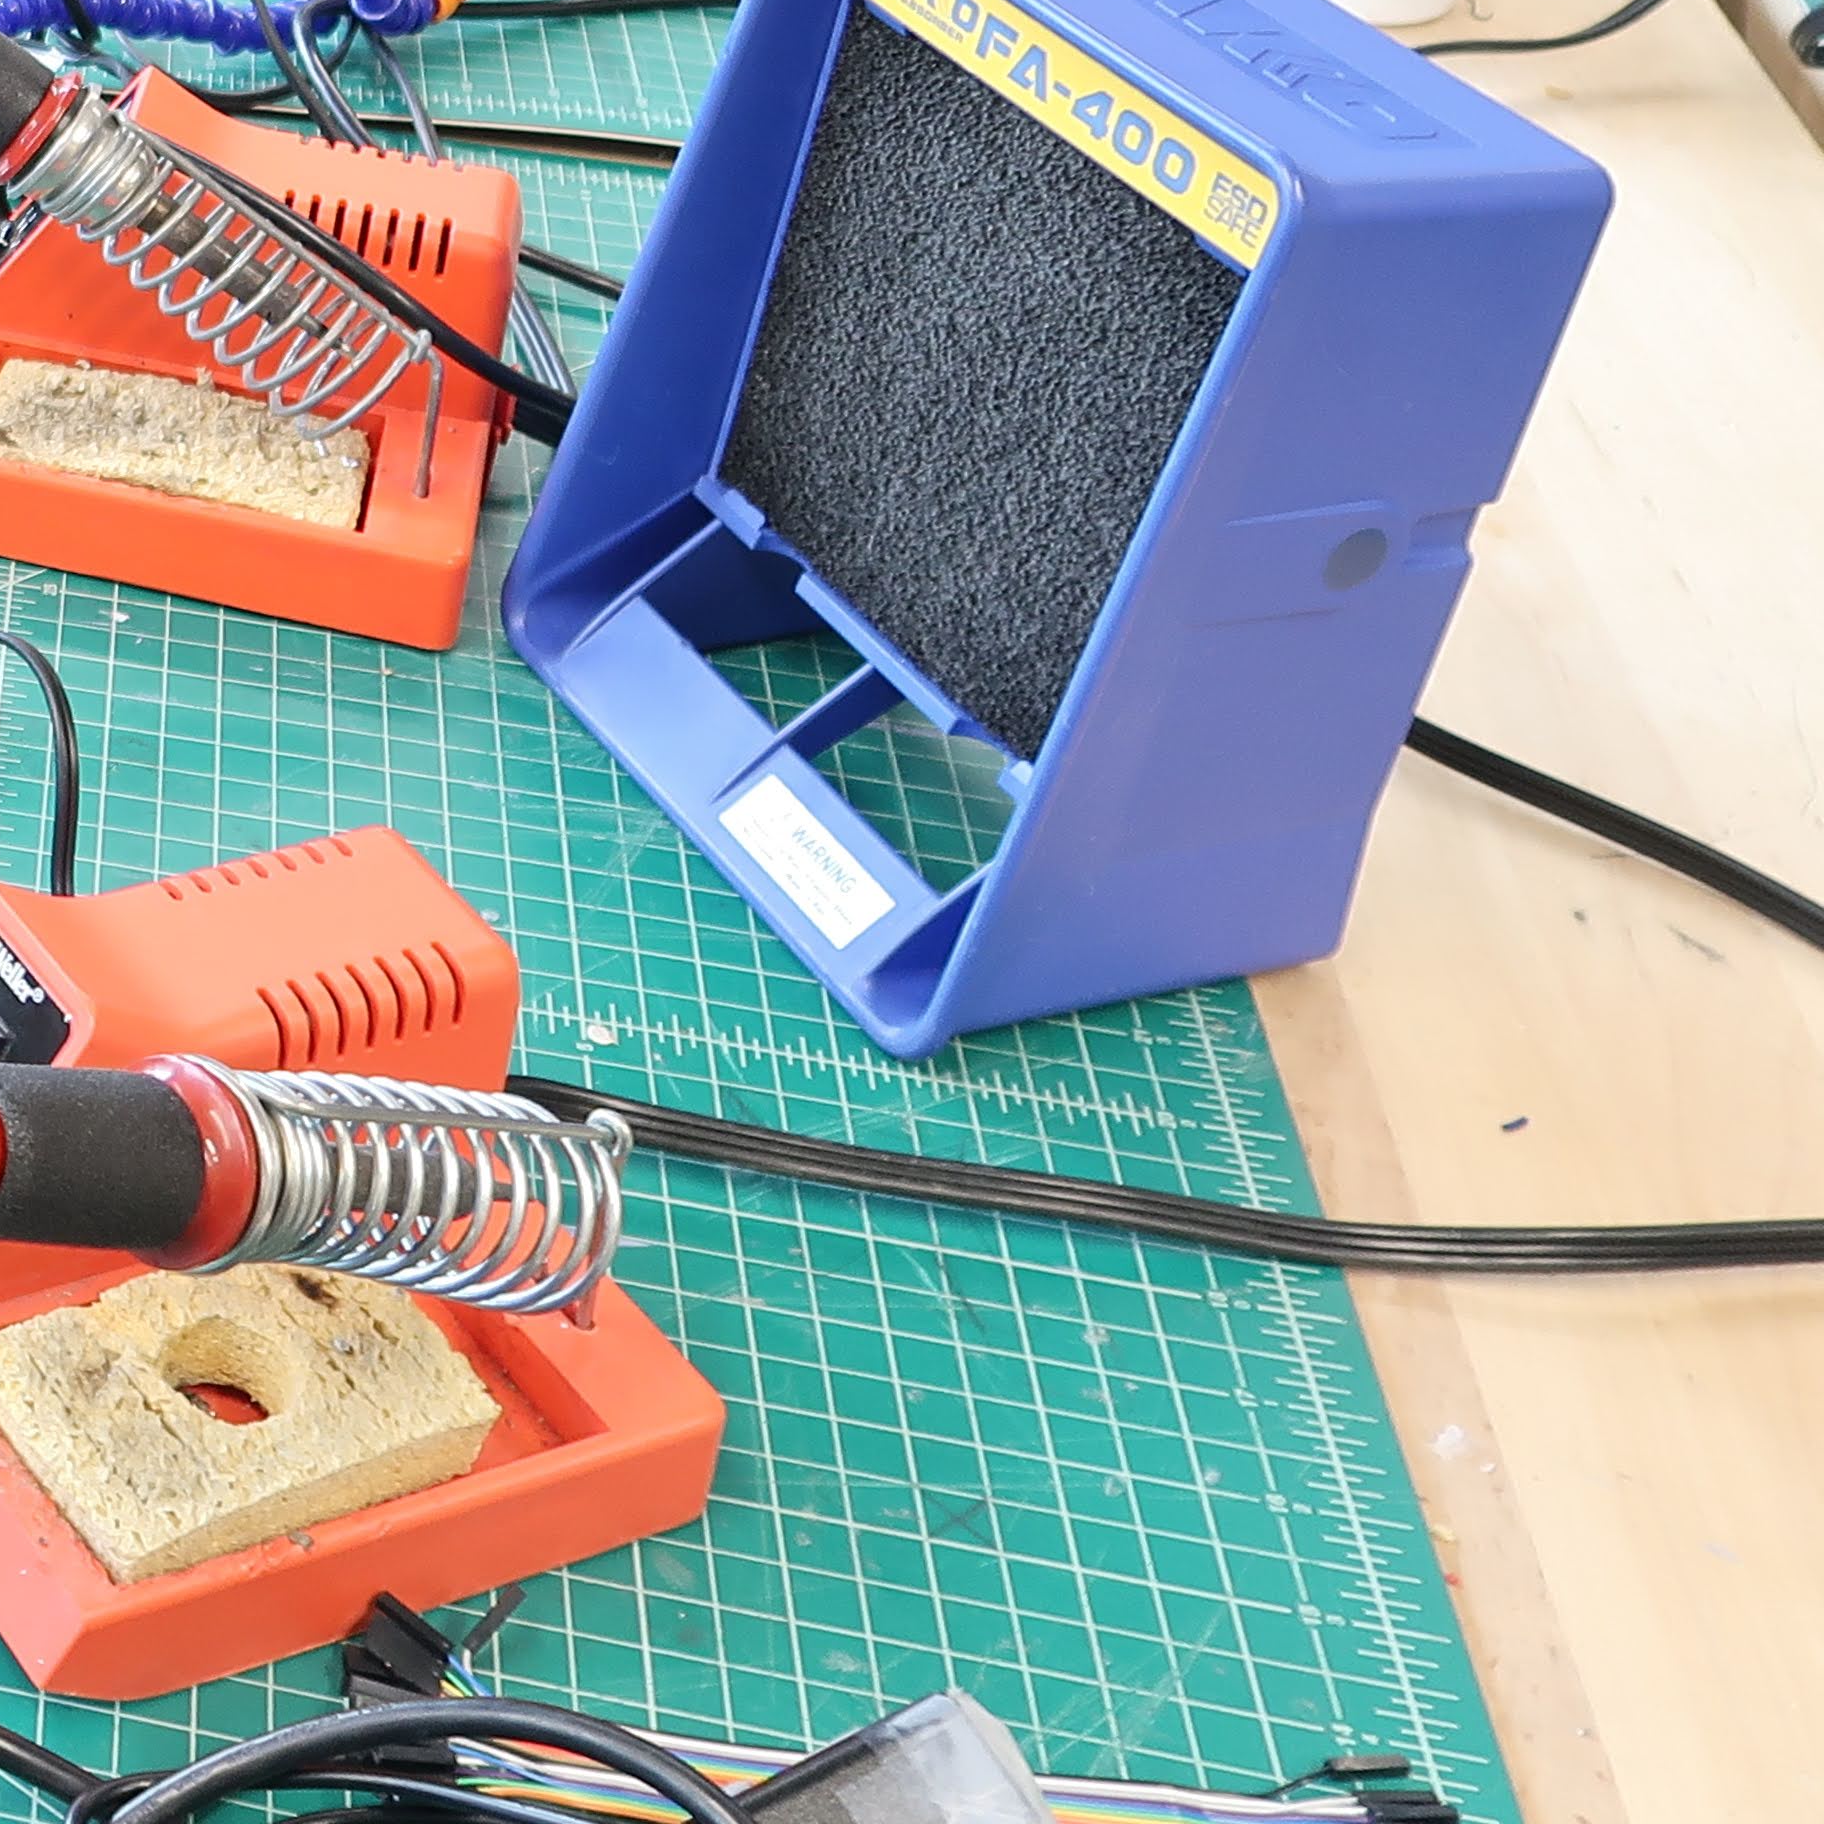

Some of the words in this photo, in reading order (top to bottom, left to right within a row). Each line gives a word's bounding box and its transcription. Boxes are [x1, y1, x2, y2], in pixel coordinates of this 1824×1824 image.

[974, 21, 1197, 196] FA-400
[1202, 193, 1263, 250] SAFE
[1209, 171, 1269, 223] ESD
[792, 824, 857, 894] WARNING
